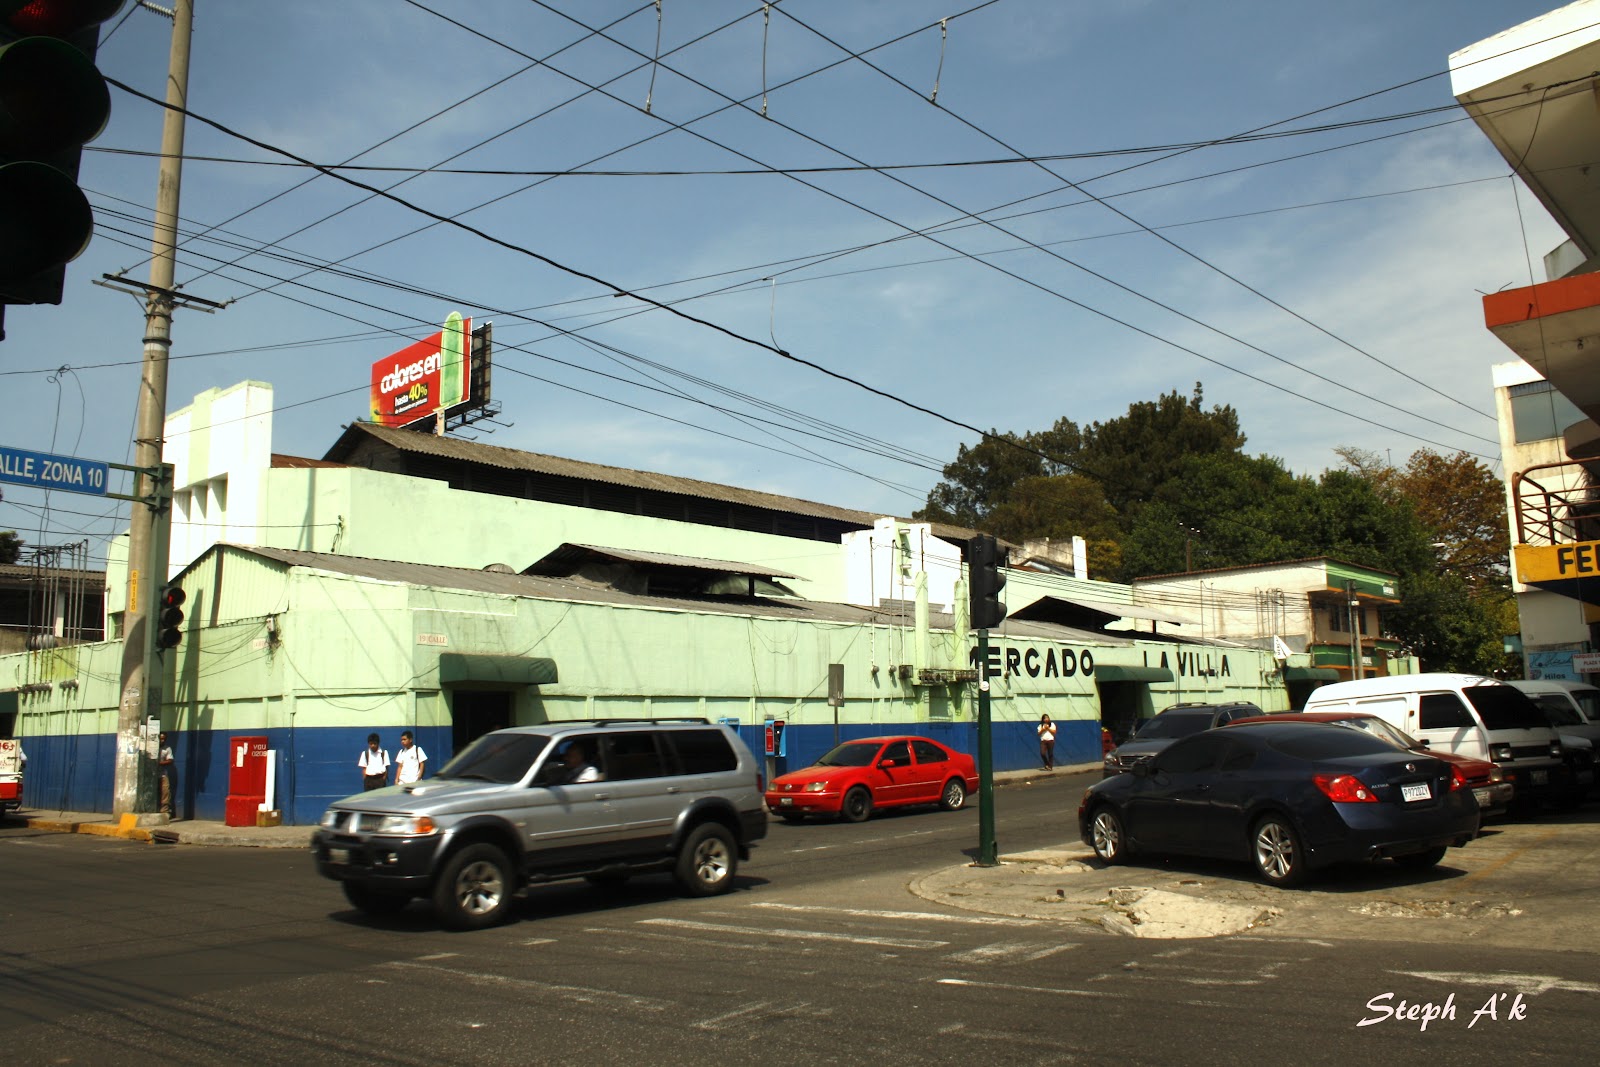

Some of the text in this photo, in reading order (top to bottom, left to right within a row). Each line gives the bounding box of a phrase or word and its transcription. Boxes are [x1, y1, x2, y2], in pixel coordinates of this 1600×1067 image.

[381, 352, 441, 394] colores en
[409, 383, 427, 401] 40%
[41, 461, 83, 485] ZONA
[88, 467, 103, 487] 10
[1176, 651, 1231, 677] VILLA
[1544, 672, 1566, 680] Hilos
